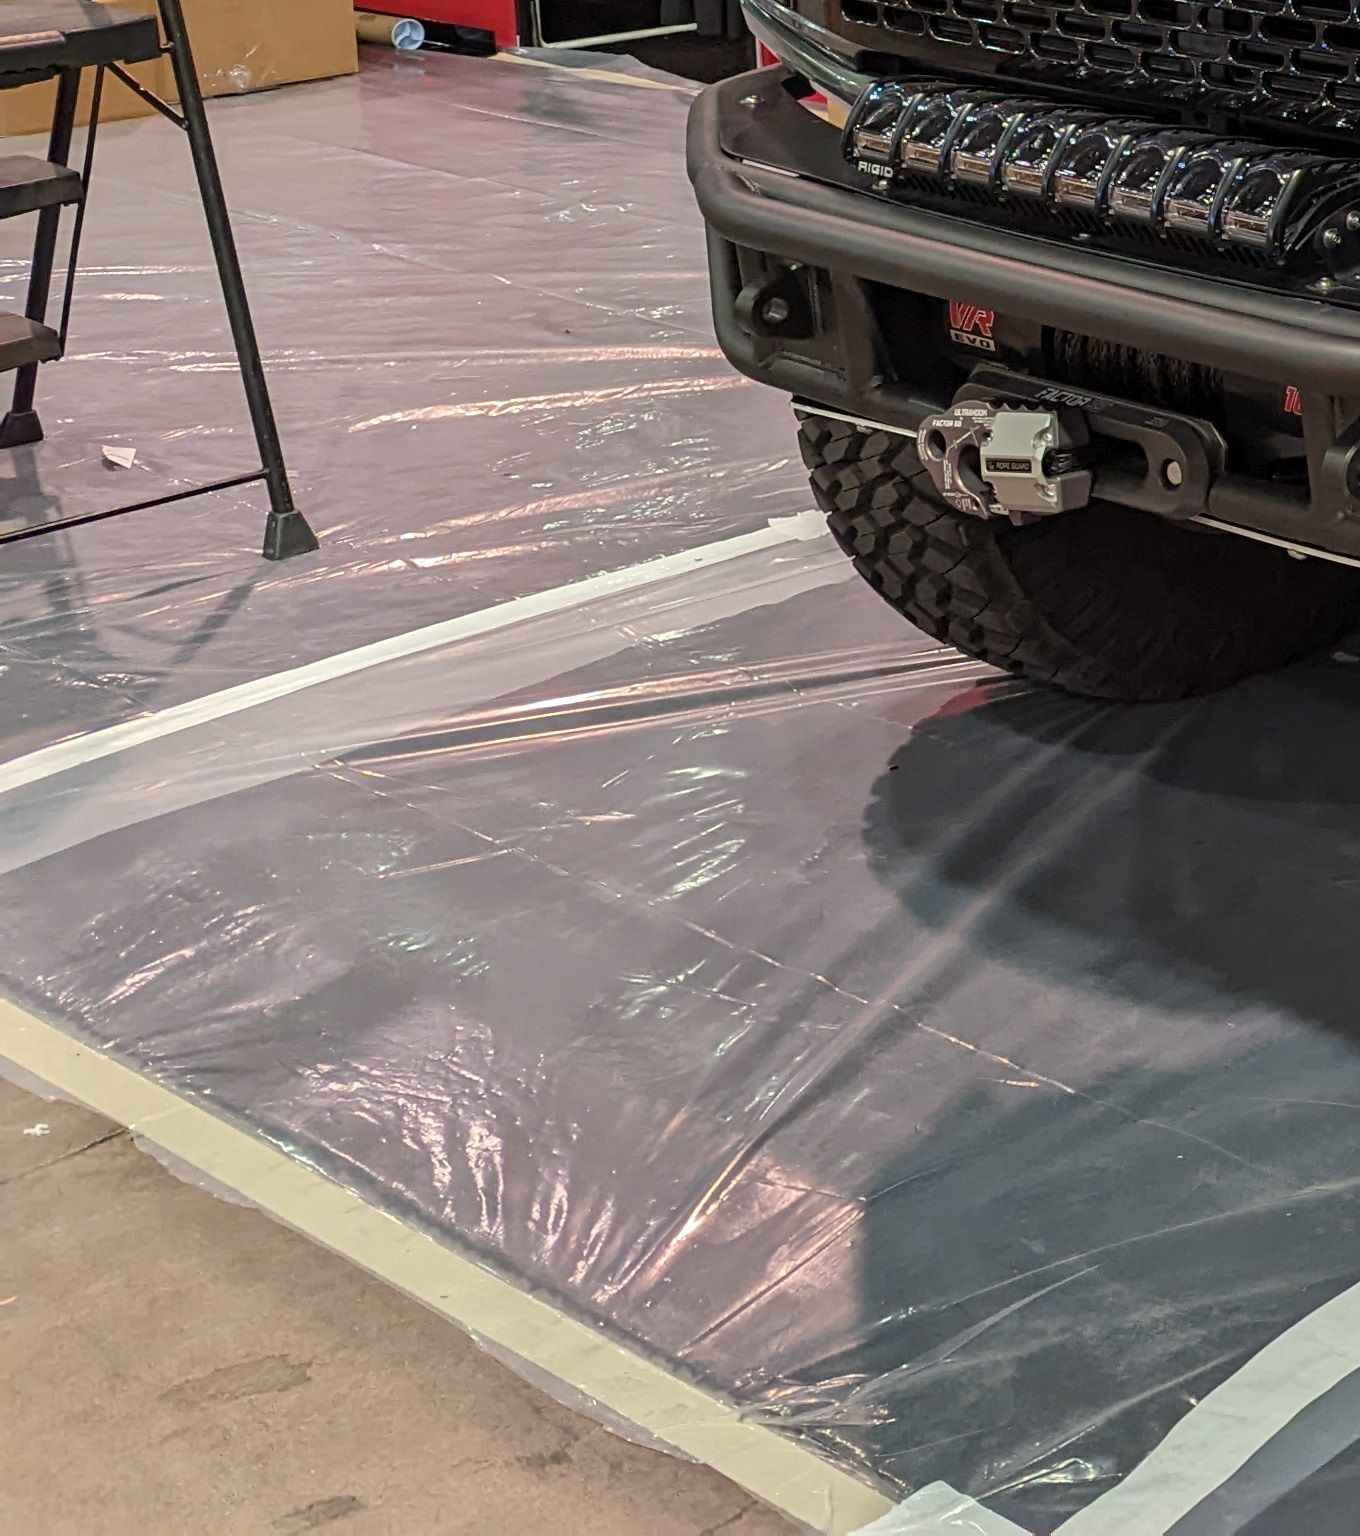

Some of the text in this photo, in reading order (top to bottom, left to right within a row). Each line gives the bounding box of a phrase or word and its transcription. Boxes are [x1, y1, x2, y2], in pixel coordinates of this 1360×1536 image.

[858, 160, 893, 178] RIGID
[949, 299, 995, 338] VR
[953, 332, 991, 349] EVO
[1035, 387, 1092, 407] FACTOR
